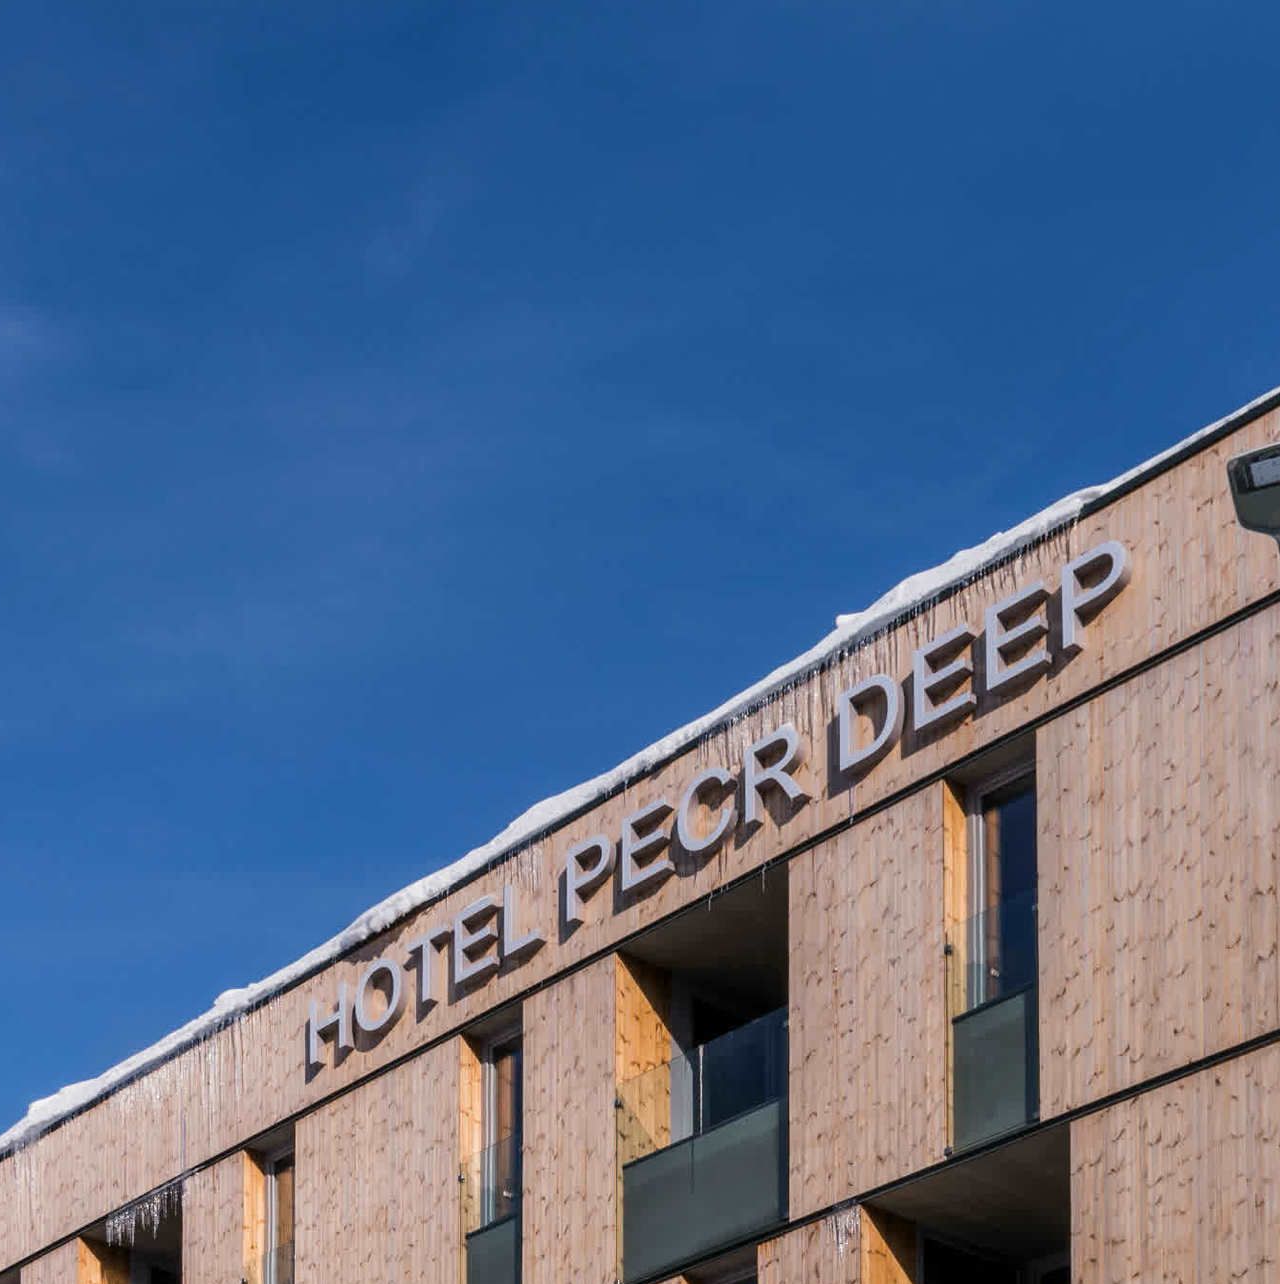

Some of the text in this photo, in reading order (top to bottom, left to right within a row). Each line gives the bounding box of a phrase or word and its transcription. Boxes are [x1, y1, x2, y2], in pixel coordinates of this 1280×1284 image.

[307, 540, 1132, 1066] HOTEL PECR DEEP
